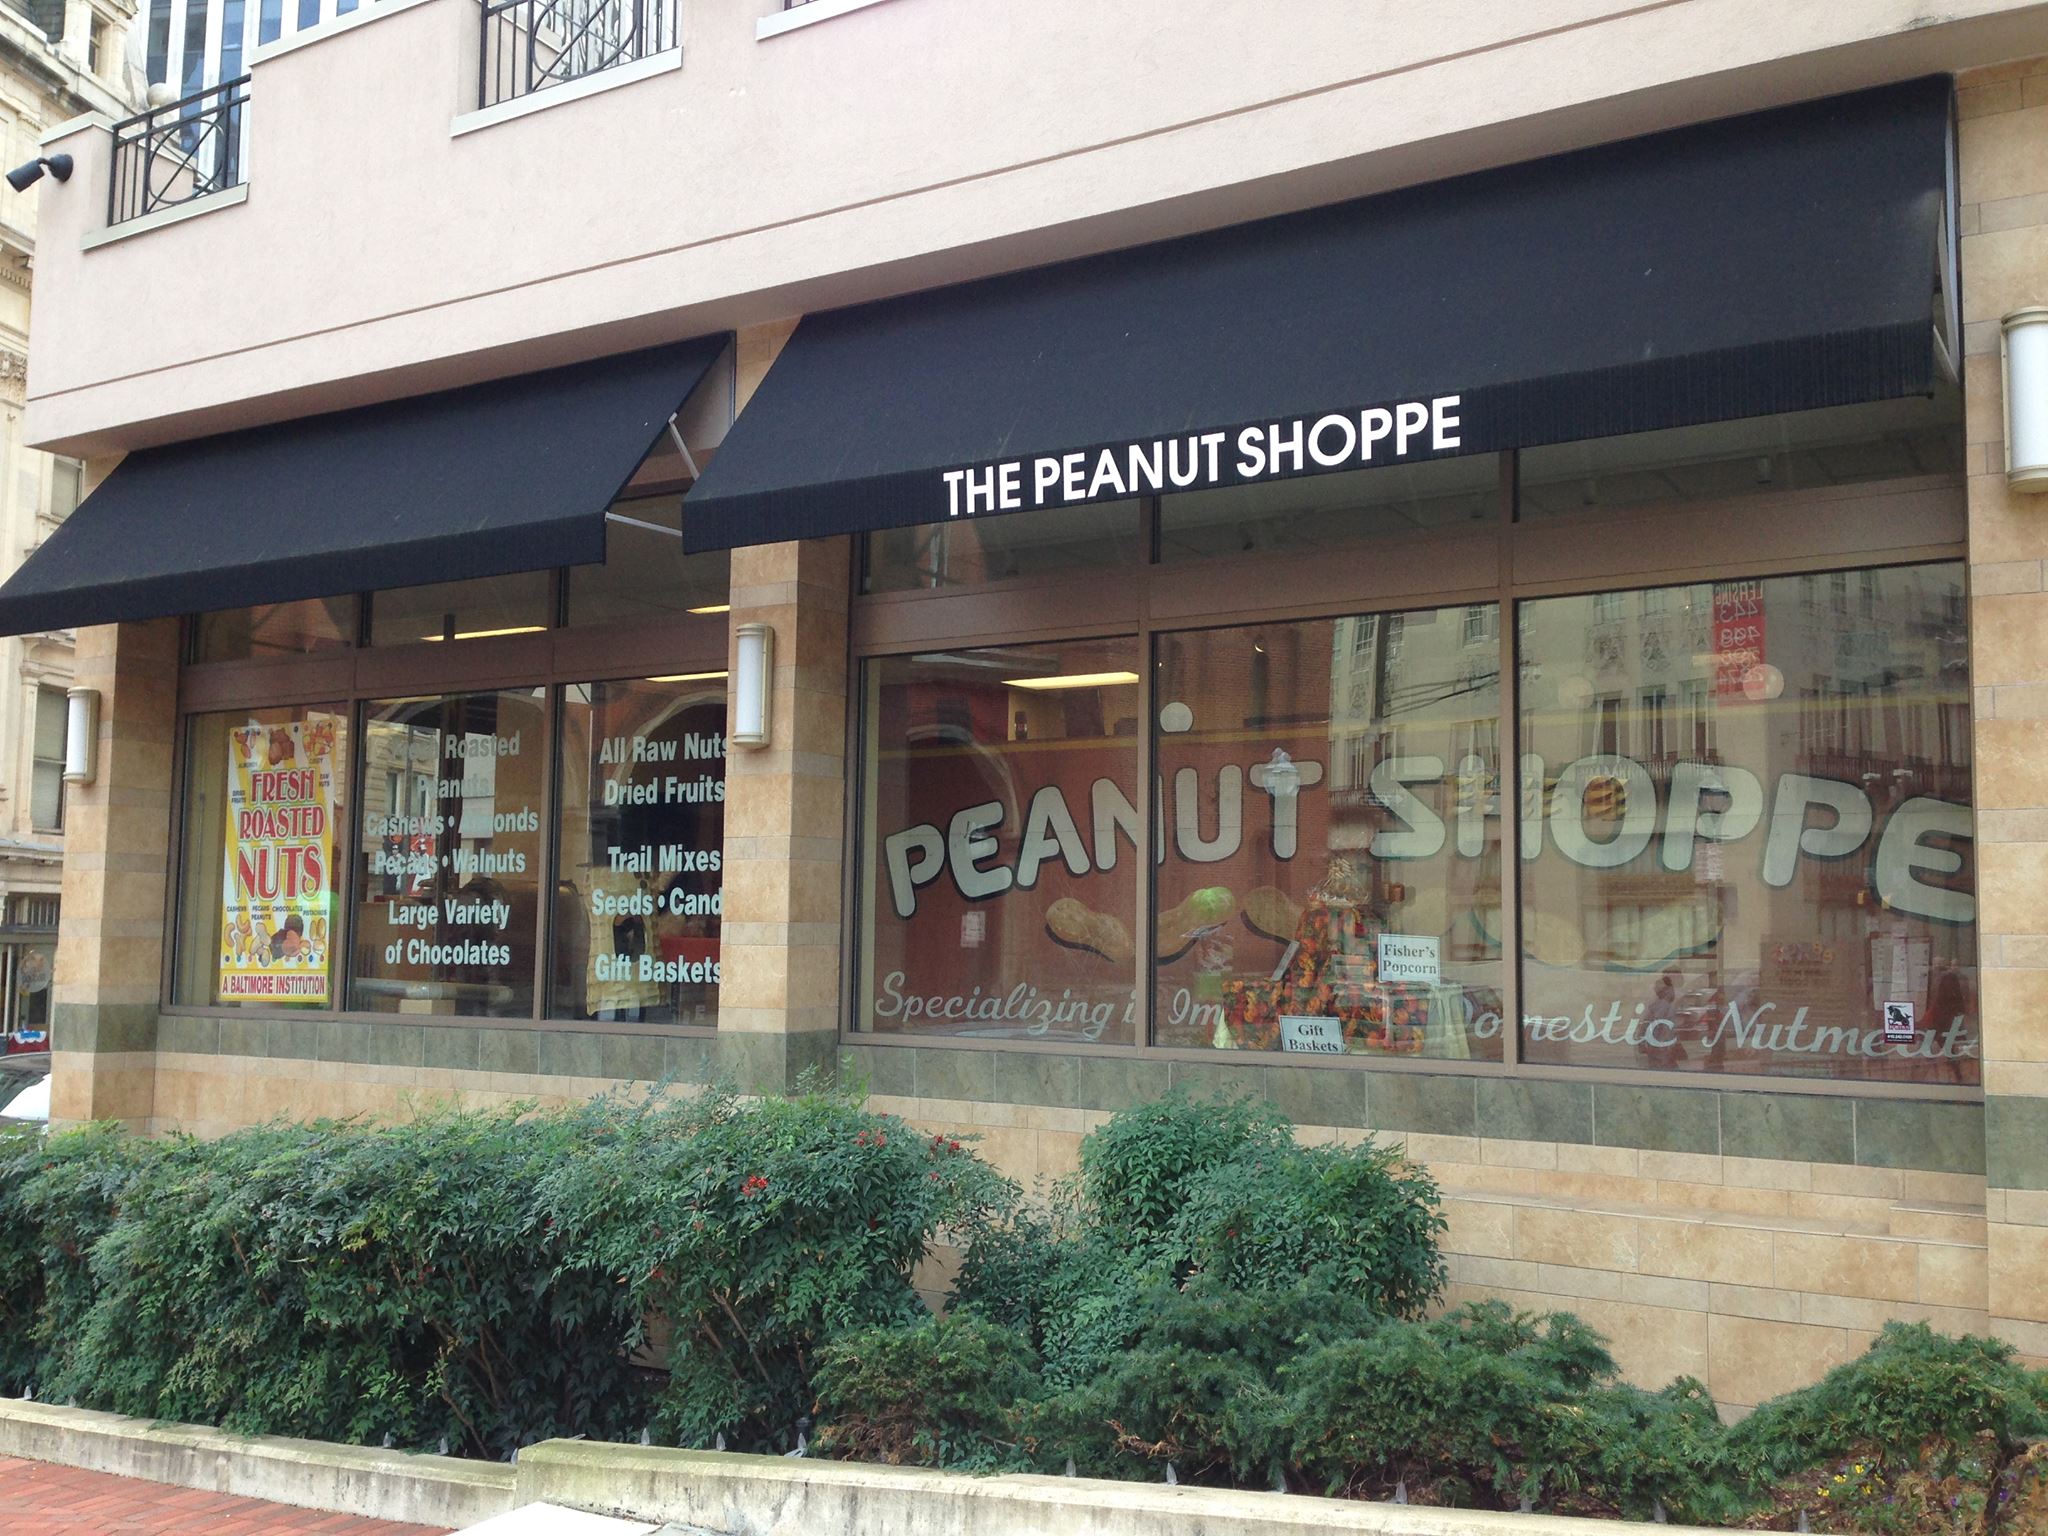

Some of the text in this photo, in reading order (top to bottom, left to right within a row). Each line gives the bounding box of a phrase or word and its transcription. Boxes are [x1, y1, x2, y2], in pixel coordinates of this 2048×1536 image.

[943, 395, 1460, 516] THE PEANUT SHOPPE
[445, 730, 520, 759] Roasted
[599, 732, 727, 764] All Raw Nuts
[251, 769, 315, 802] FRESH
[417, 773, 490, 799] Panuts
[604, 774, 725, 806] Dried Fruits
[240, 806, 325, 839] ROASTED
[458, 806, 538, 833] onds
[885, 754, 1976, 923] PEANUT SHOPPE
[237, 846, 322, 899] NUTS
[452, 848, 525, 874] Walnuts
[608, 844, 721, 873] Trail Mixes
[389, 898, 510, 930] Large Variety
[592, 887, 723, 916] Seeds Cand
[385, 938, 510, 966] of Chocolates
[1384, 944, 1435, 958] Fisher's
[595, 953, 720, 984] Gift Baskets
[1383, 960, 1437, 975] Popcorn
[222, 975, 325, 994] A BALTIMORE INSTITUTION
[874, 971, 1115, 1041] Specializing
[1298, 1023, 1324, 1037] Gift
[1289, 1038, 1339, 1052] Baskets
